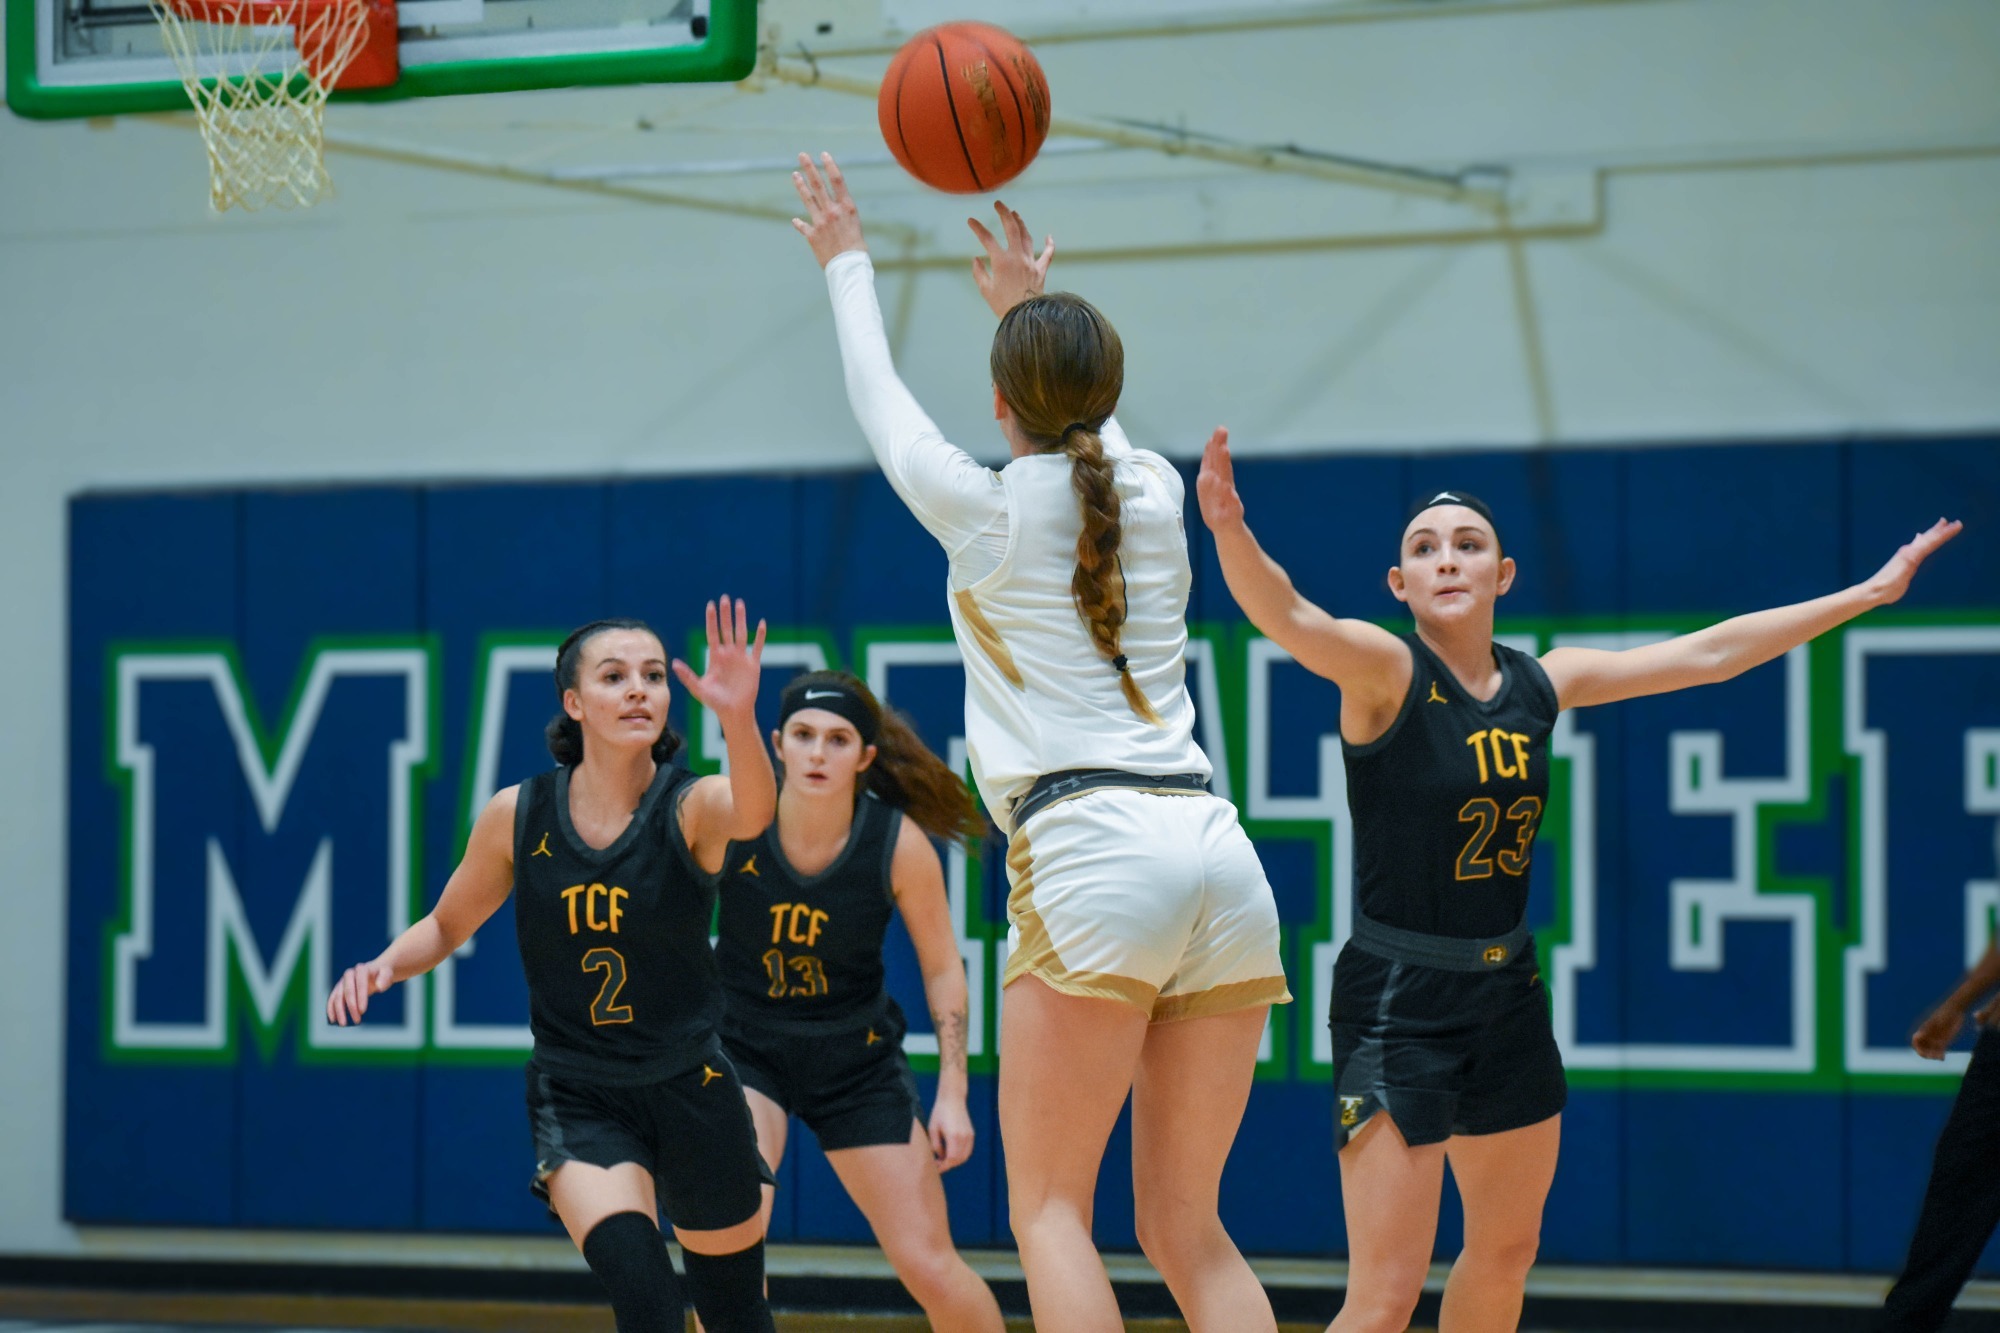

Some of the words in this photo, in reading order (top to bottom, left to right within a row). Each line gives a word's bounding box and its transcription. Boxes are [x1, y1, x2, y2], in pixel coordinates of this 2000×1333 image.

[1466, 728, 1531, 784] TCF
[107, 613, 2000, 1090] MNEE
[1455, 796, 1542, 881] 23
[561, 883, 629, 934] TCF
[770, 903, 829, 947] TCF
[582, 947, 633, 1026] 2
[762, 949, 828, 997] 13
